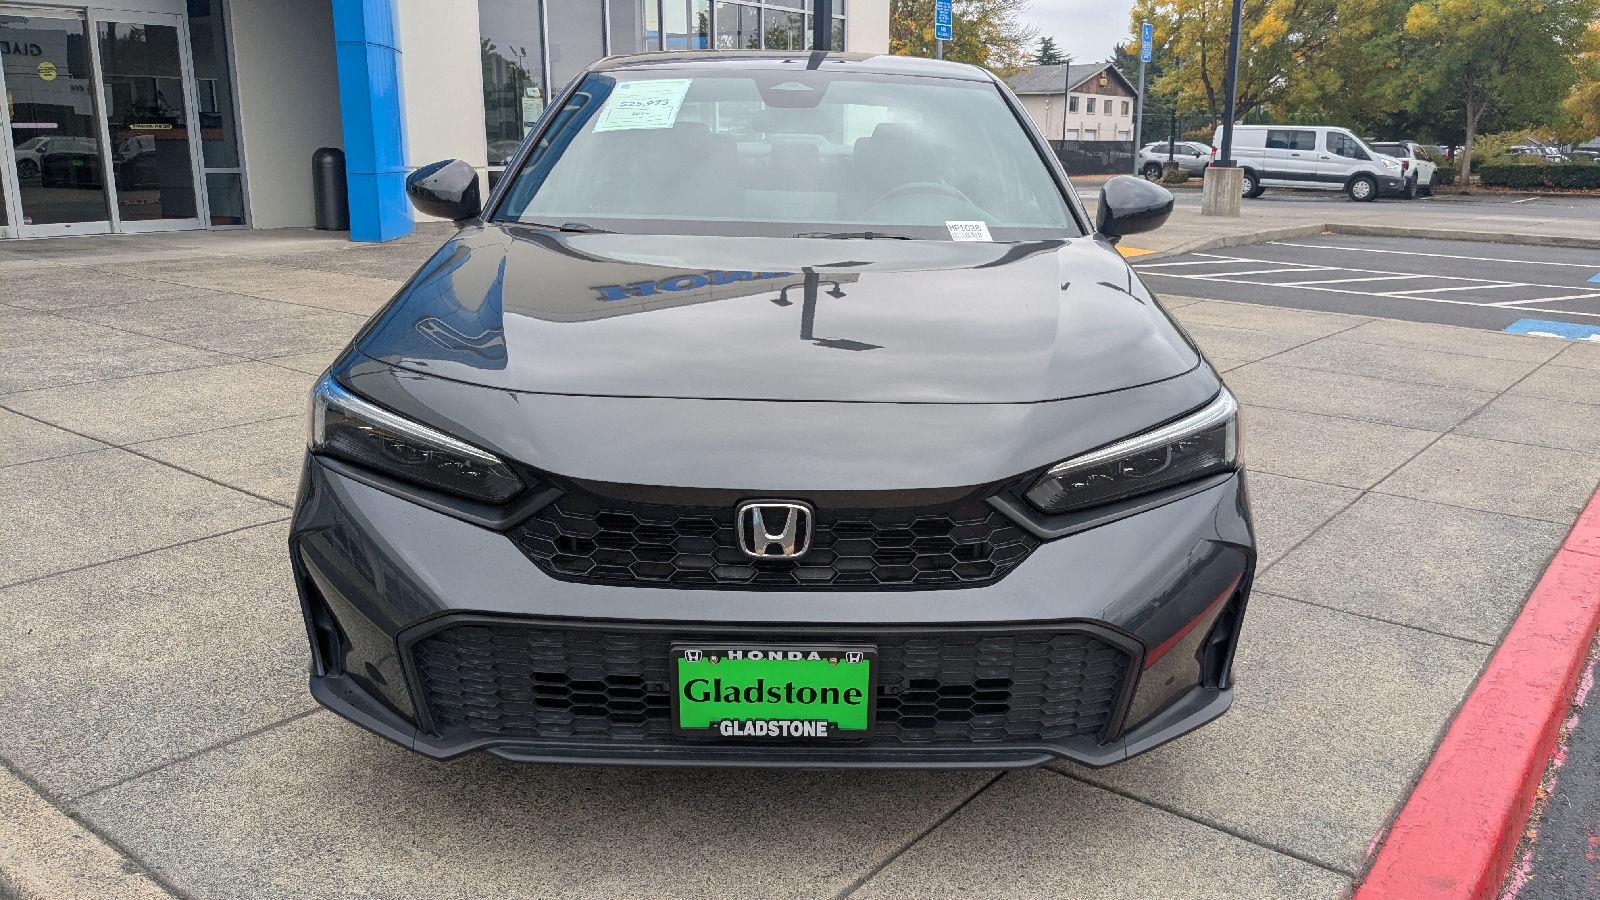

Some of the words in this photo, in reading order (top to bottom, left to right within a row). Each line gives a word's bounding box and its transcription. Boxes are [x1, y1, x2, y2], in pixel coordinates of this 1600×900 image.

[728, 651, 821, 661] HONDA
[683, 678, 863, 705] Gladstone
[720, 720, 828, 737] GLADSTONE
